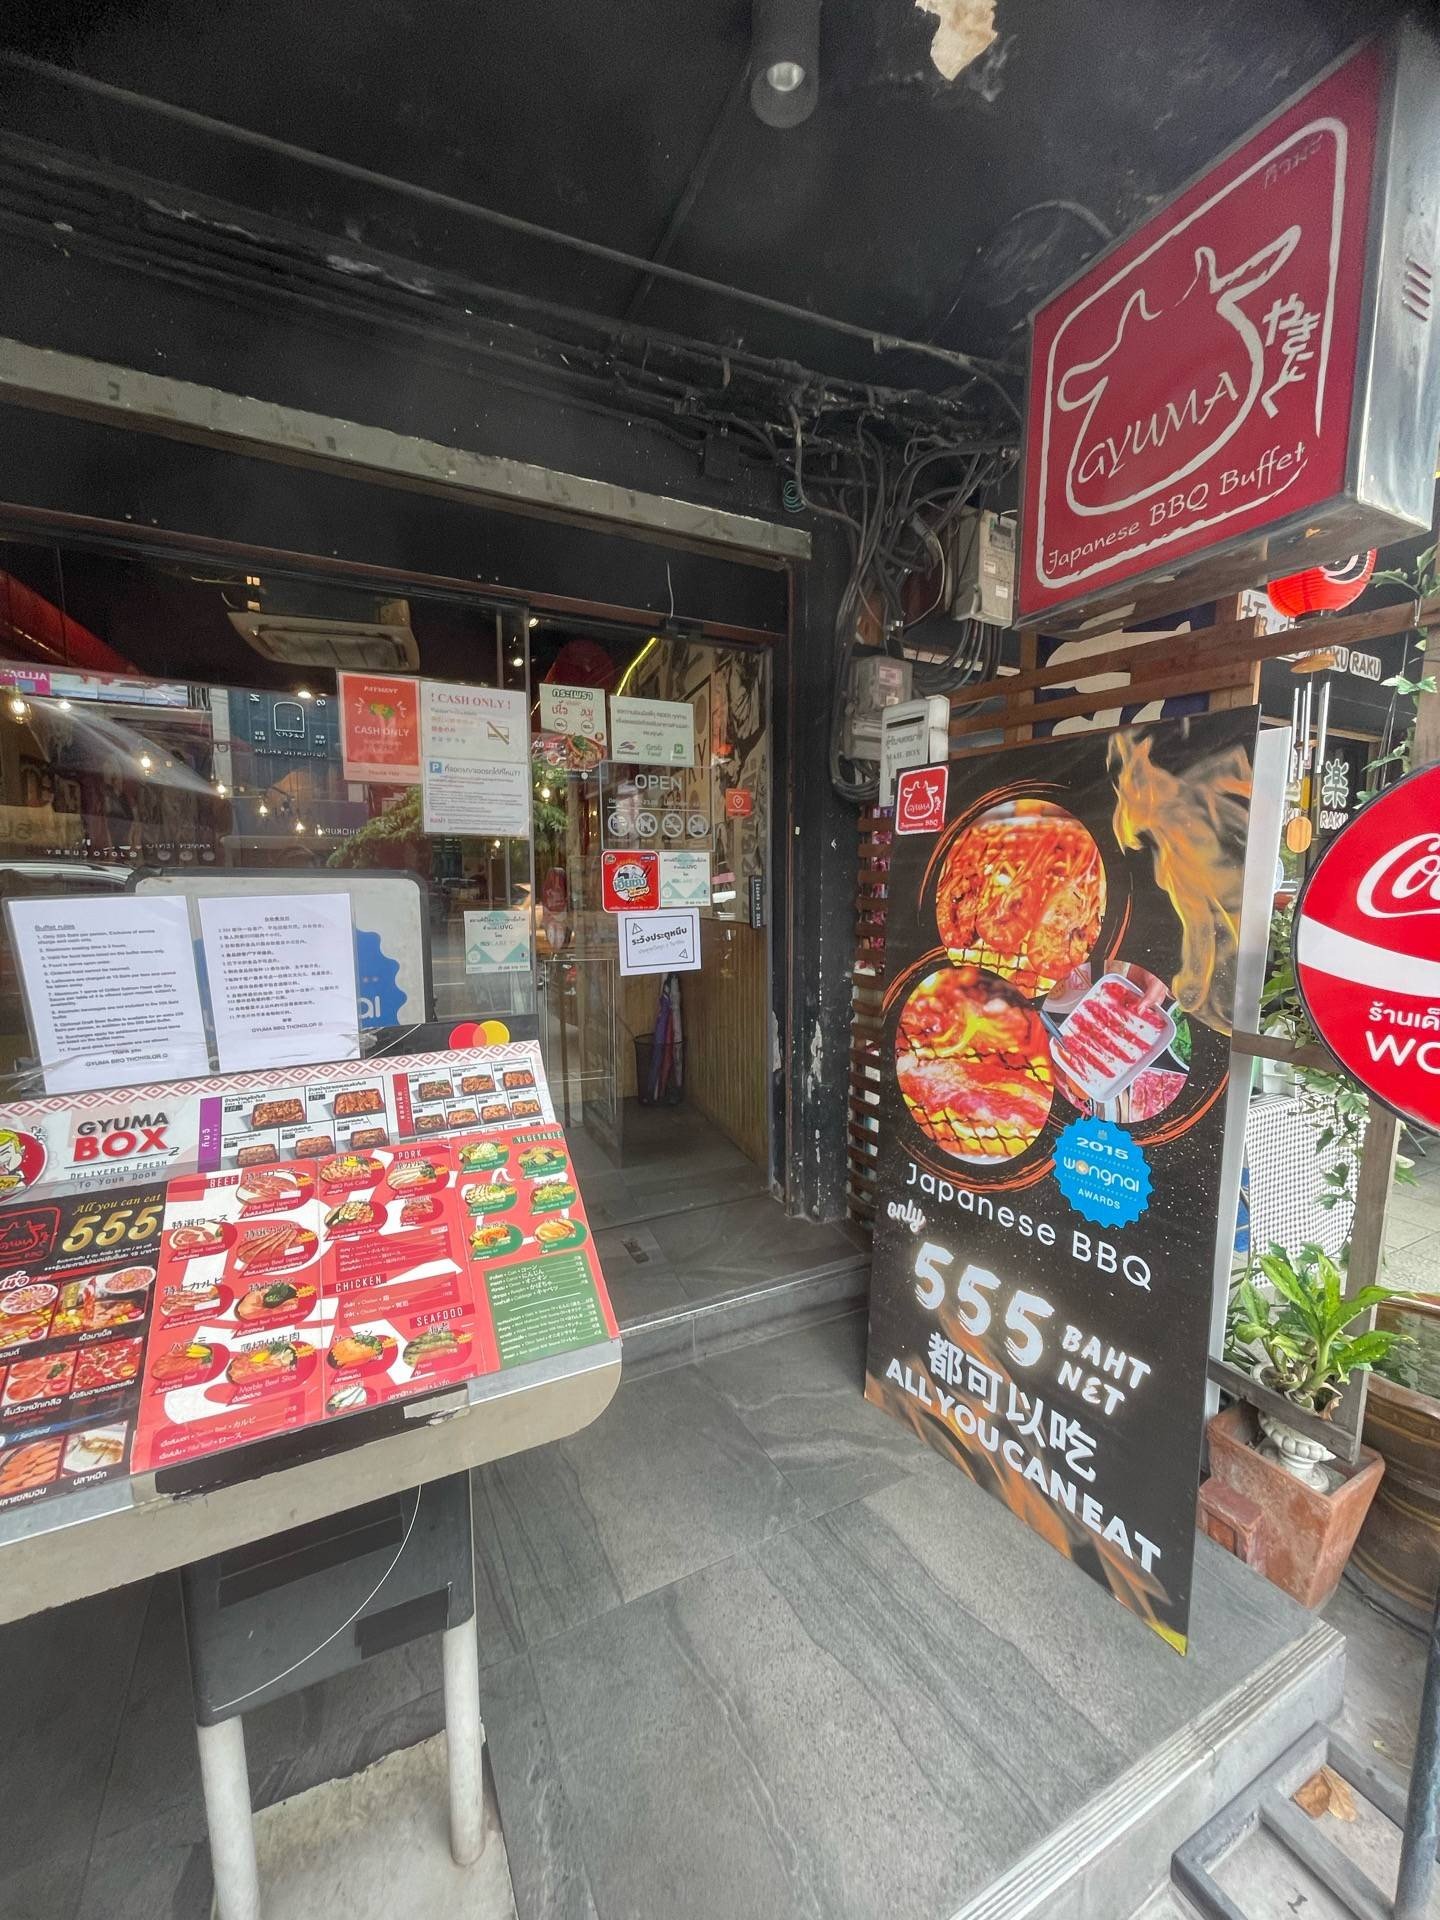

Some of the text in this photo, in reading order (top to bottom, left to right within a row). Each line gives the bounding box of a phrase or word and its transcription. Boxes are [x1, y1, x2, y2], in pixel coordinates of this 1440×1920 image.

[1078, 372, 1239, 484] GYUMA
[1046, 441, 1309, 574] Japanese BBQ Buffet
[1351, 652, 1381, 679] RAKU
[364, 685, 398, 694] PAYMENT
[438, 693, 469, 706] CASH
[472, 696, 505, 708] ONLY
[354, 725, 410, 738] CASH ONLY
[432, 763, 440, 772] P
[635, 774, 682, 790] OPEN
[632, 926, 688, 946] ระวังประตูหนีบ
[77, 1112, 169, 1136] GYUMA
[73, 1126, 169, 1162] BOX
[516, 1131, 562, 1143] VEGETABLE
[1076, 1136, 1129, 1160] 2015
[398, 1150, 421, 1160] PORK
[70, 1160, 168, 1180] DELIVERED FRESH
[78, 1171, 157, 1189] TO YOUR DOOR
[1063, 1156, 1140, 1193] wongnai
[209, 1176, 237, 1188] BEEF
[72, 1193, 161, 1216] All you can eat
[1078, 1188, 1121, 1210] AWARDS
[887, 1200, 926, 1235] only
[907, 1162, 1152, 1291] Japanese BBQ
[335, 1275, 382, 1292] CHICKEN
[914, 1241, 1055, 1367] 555
[416, 1307, 463, 1327] SEAFOOD
[1062, 1325, 1152, 1389] BAHT
[1058, 1360, 1126, 1416] NET
[927, 1331, 1098, 1483] 都可以吃
[885, 1357, 1163, 1574] ALL YOU CAN EAT
[73, 1471, 107, 1486] ปลาหมึก
